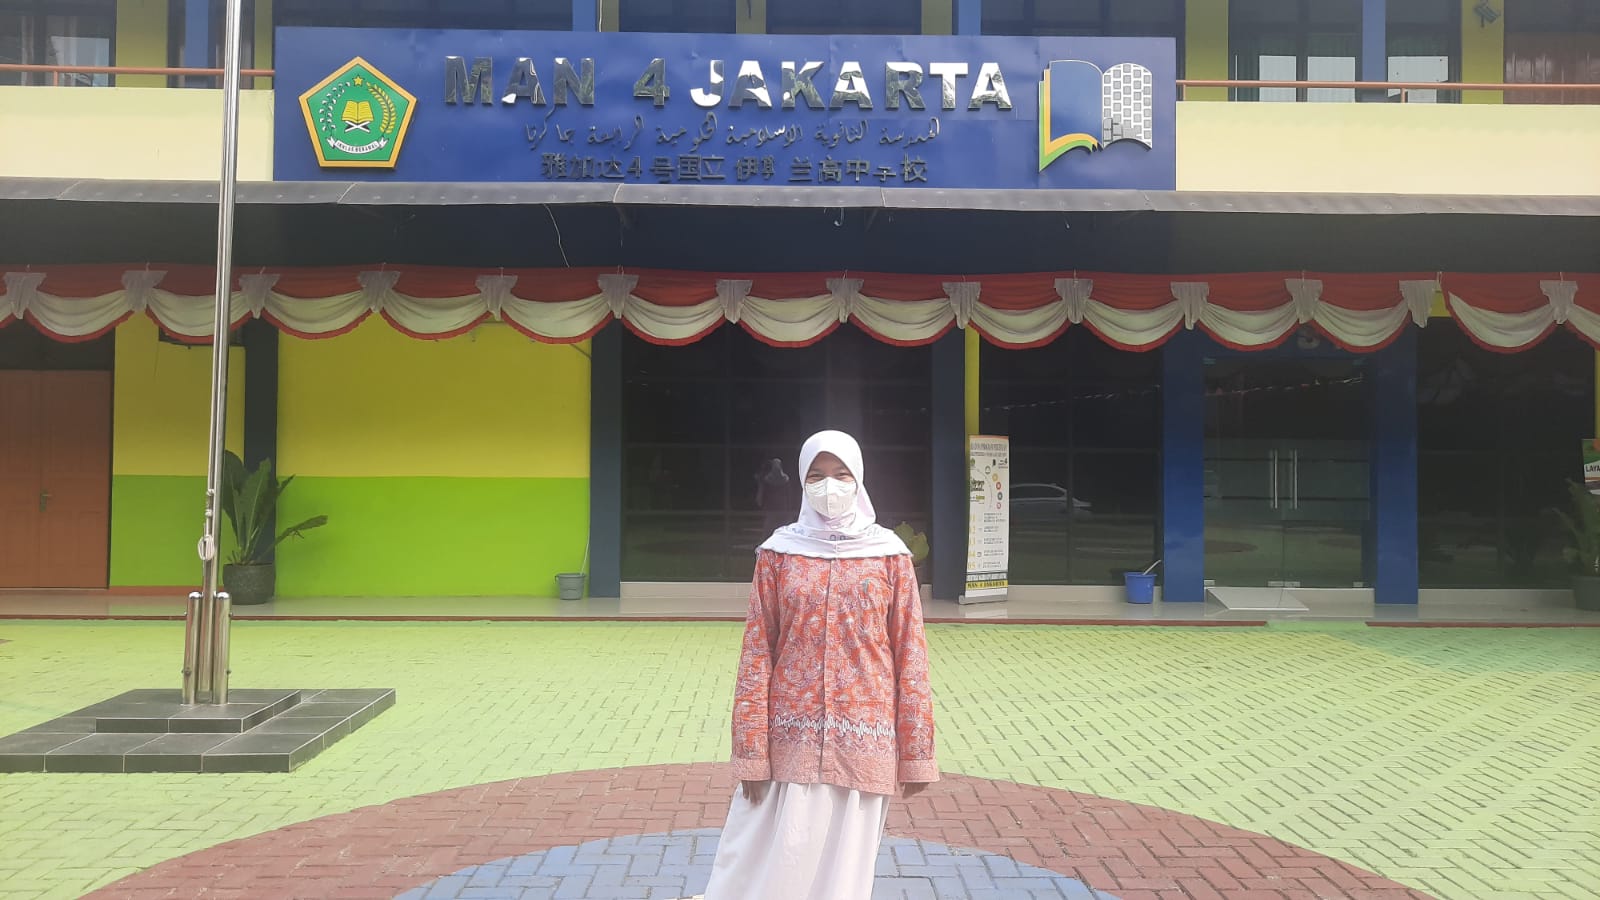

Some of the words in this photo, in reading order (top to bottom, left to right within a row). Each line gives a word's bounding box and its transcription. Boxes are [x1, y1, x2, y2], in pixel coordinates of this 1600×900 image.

[445, 55, 594, 105] MAN
[633, 58, 670, 106] 4
[690, 59, 1013, 110] JAKARTA
